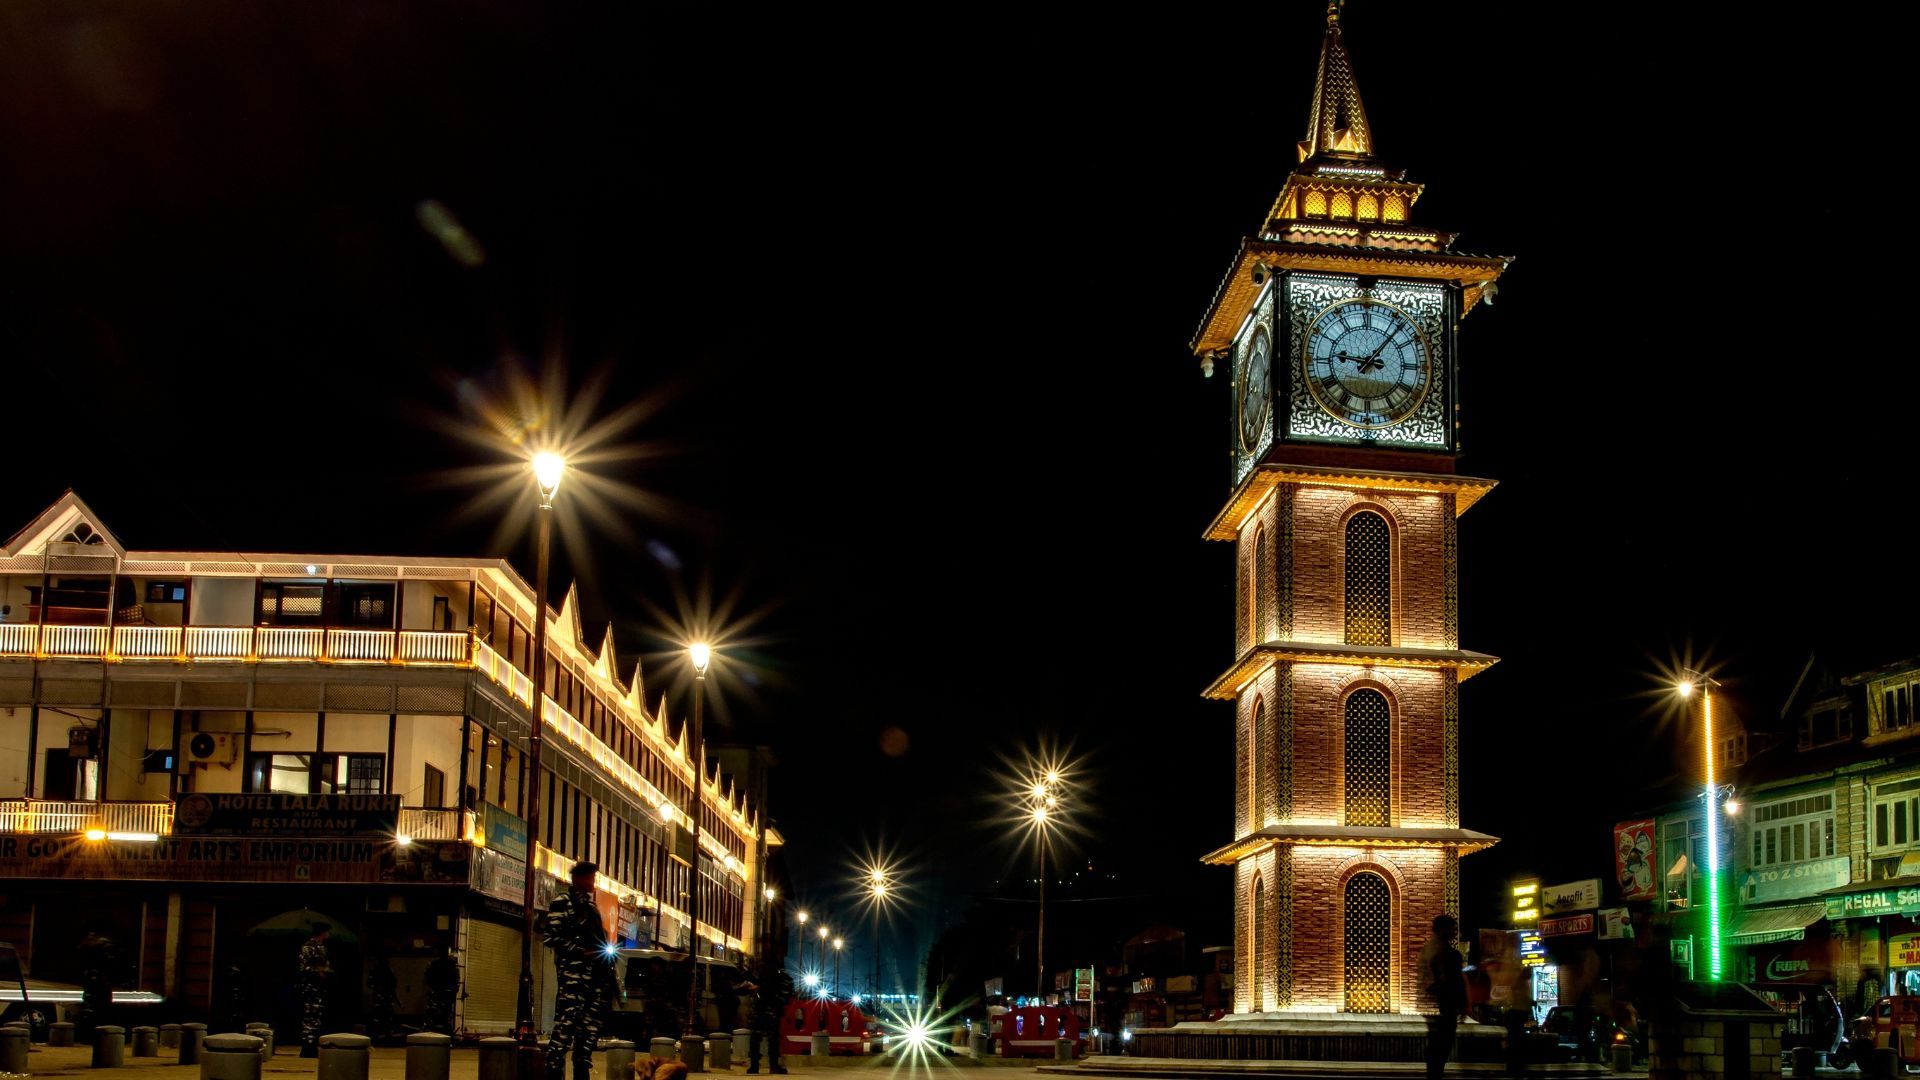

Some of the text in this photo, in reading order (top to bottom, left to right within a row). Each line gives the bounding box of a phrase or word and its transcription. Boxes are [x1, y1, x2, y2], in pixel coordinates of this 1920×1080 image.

[217, 794, 396, 812] HOTEL LALA RUKH
[292, 811, 319, 819] AND
[251, 817, 357, 830] RESTAURANT
[187, 840, 241, 862] ARTS
[249, 840, 374, 863] EMPORIUM
[1760, 871, 1778, 883] TO
[1781, 868, 1791, 880] Z
[1556, 890, 1583, 905] Aerofit
[1844, 892, 1891, 911] REGAL
[1558, 918, 1589, 934] SPORTS
[1775, 960, 1809, 972] RUPA
